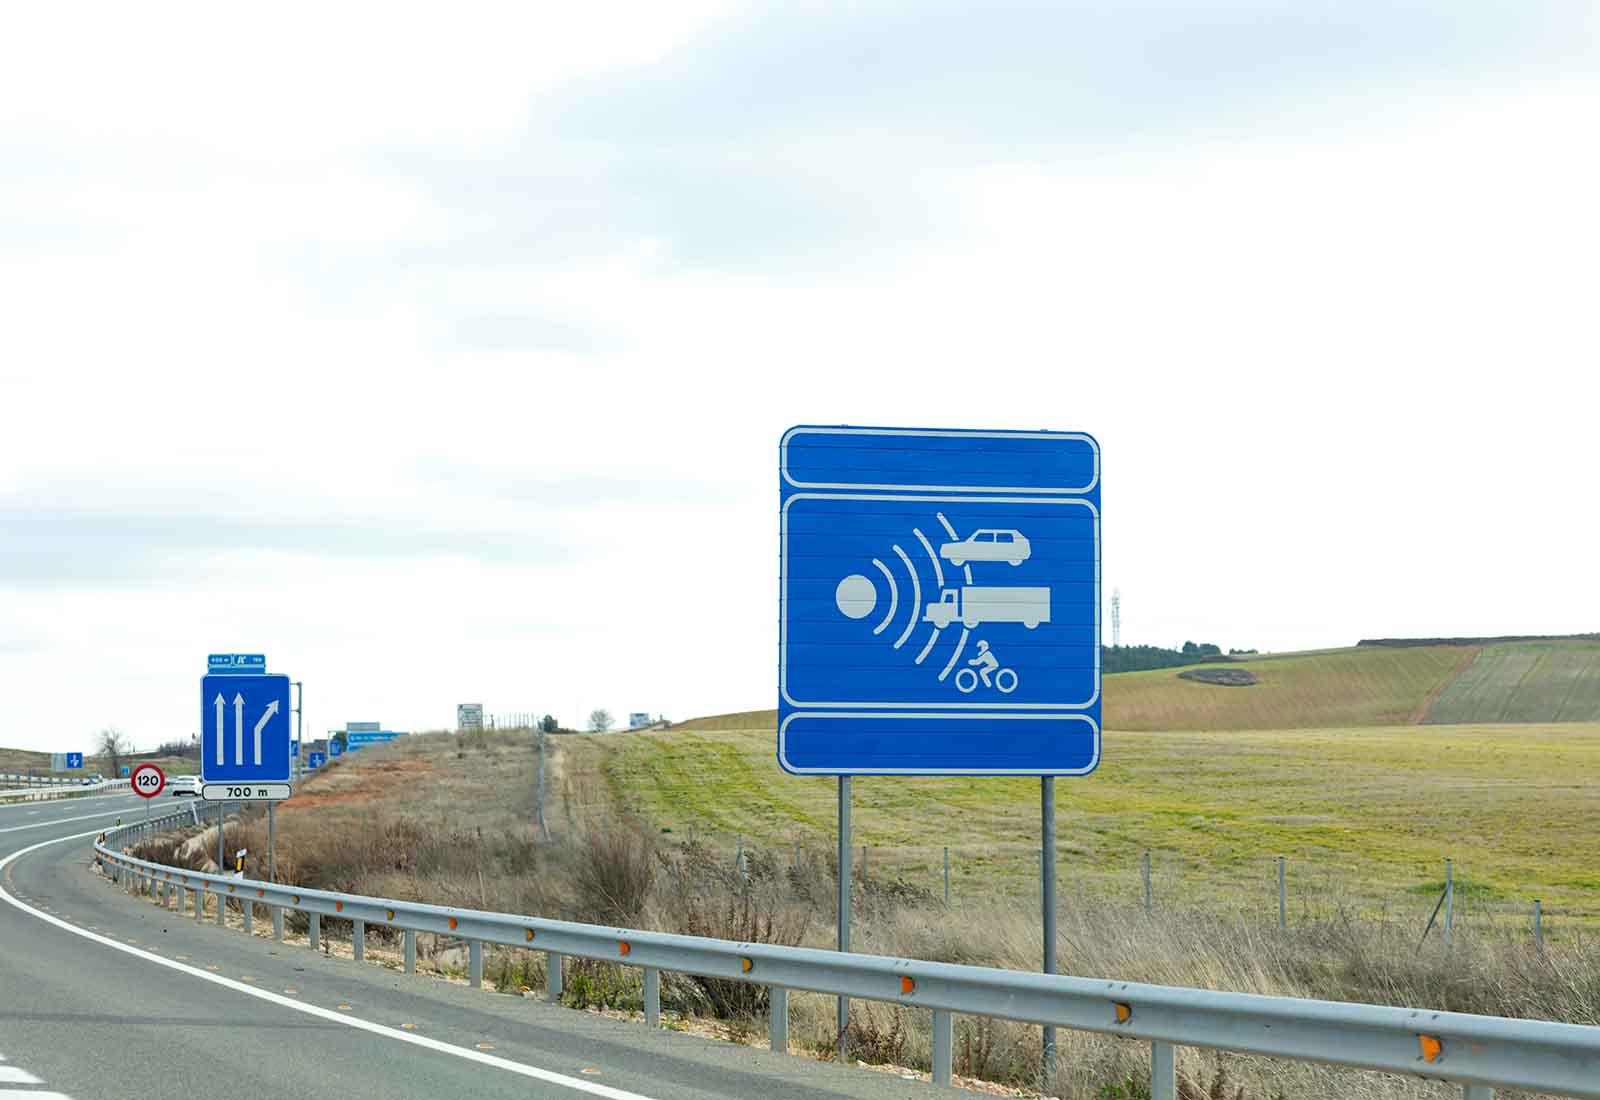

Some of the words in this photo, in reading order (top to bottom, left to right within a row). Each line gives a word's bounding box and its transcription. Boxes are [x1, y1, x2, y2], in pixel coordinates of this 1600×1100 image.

[137, 775, 159, 787] 120
[226, 787, 252, 797] 700
[258, 789, 268, 797] m
